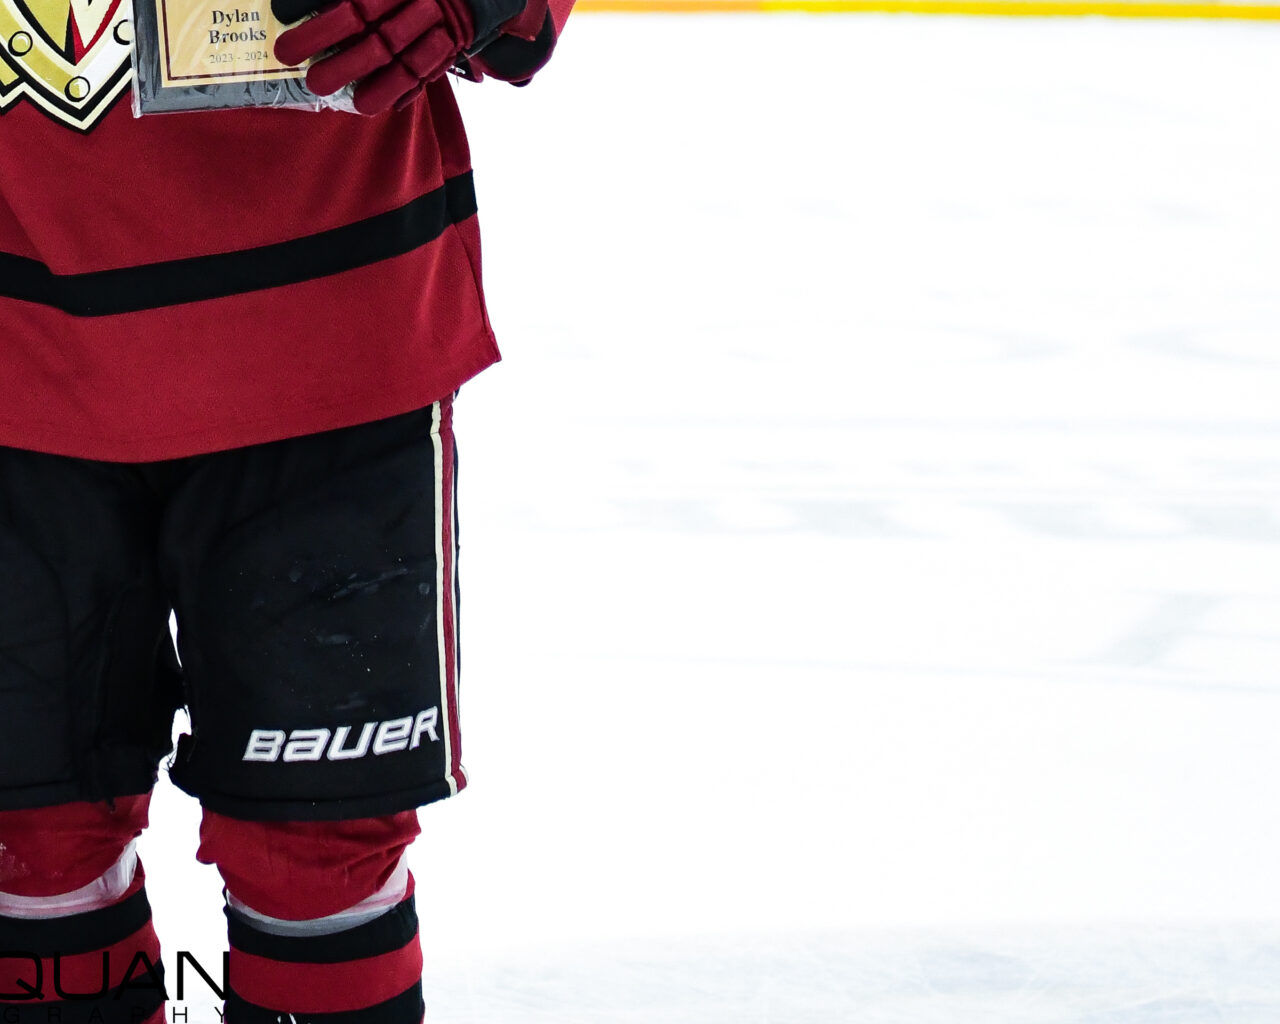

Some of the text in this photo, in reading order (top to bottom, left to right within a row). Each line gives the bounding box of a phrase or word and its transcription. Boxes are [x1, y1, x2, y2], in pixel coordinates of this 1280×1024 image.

[211, 9, 261, 26] Dylan
[209, 27, 267, 45] Brooks
[209, 52, 234, 64] 2023
[245, 50, 269, 62] 2024
[241, 706, 441, 763] BAUER
